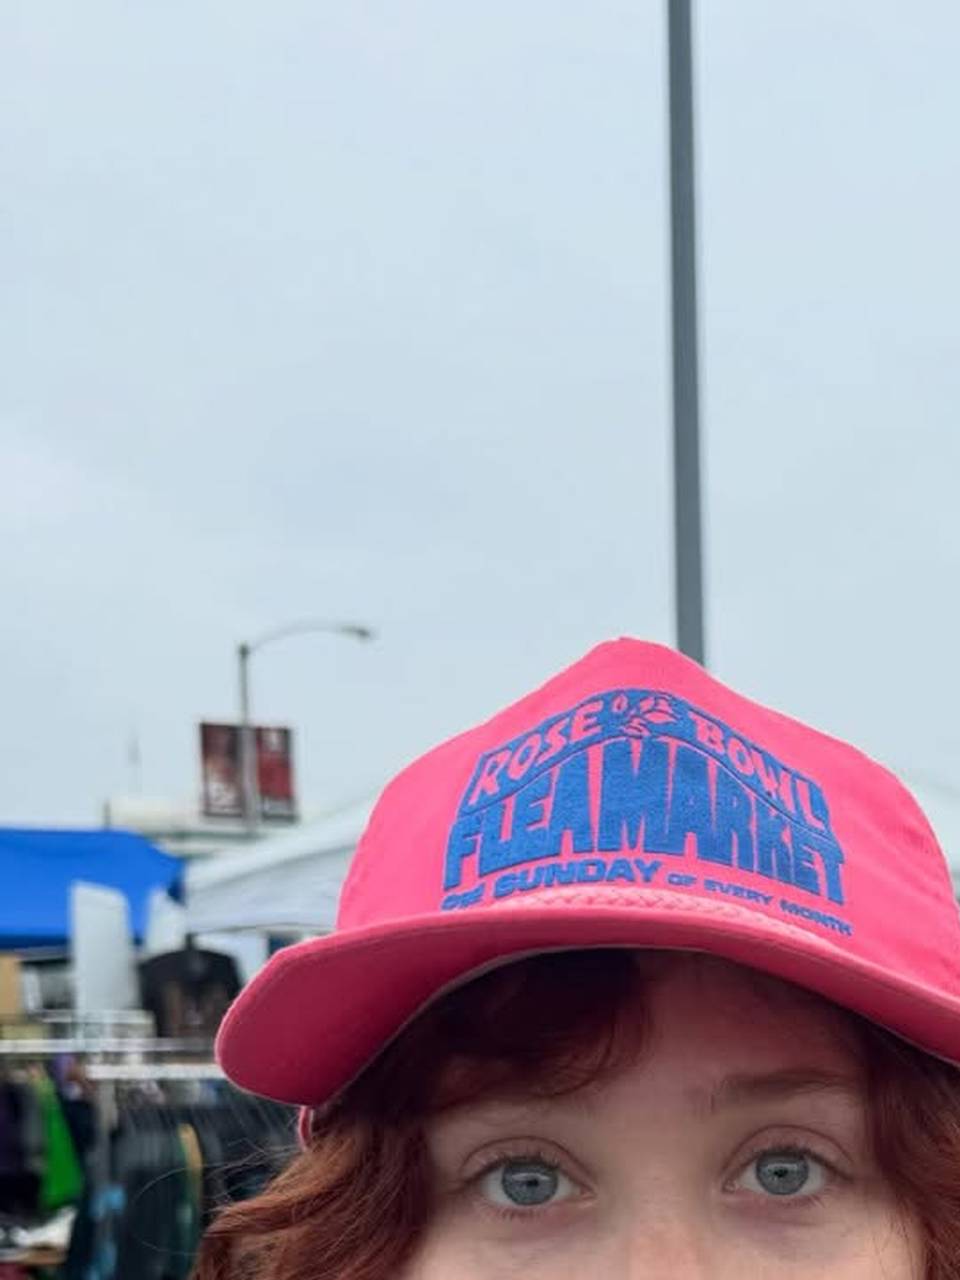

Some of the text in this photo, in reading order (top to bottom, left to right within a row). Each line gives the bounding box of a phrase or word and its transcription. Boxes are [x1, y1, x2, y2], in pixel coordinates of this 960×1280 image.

[443, 737, 845, 906] FLEA MARKET
[468, 700, 826, 831] ROSE BOWL
[494, 858, 661, 897] SUNDAY
[667, 873, 697, 886] OF
[703, 879, 773, 904] EVERY
[779, 898, 853, 936] MONTH
